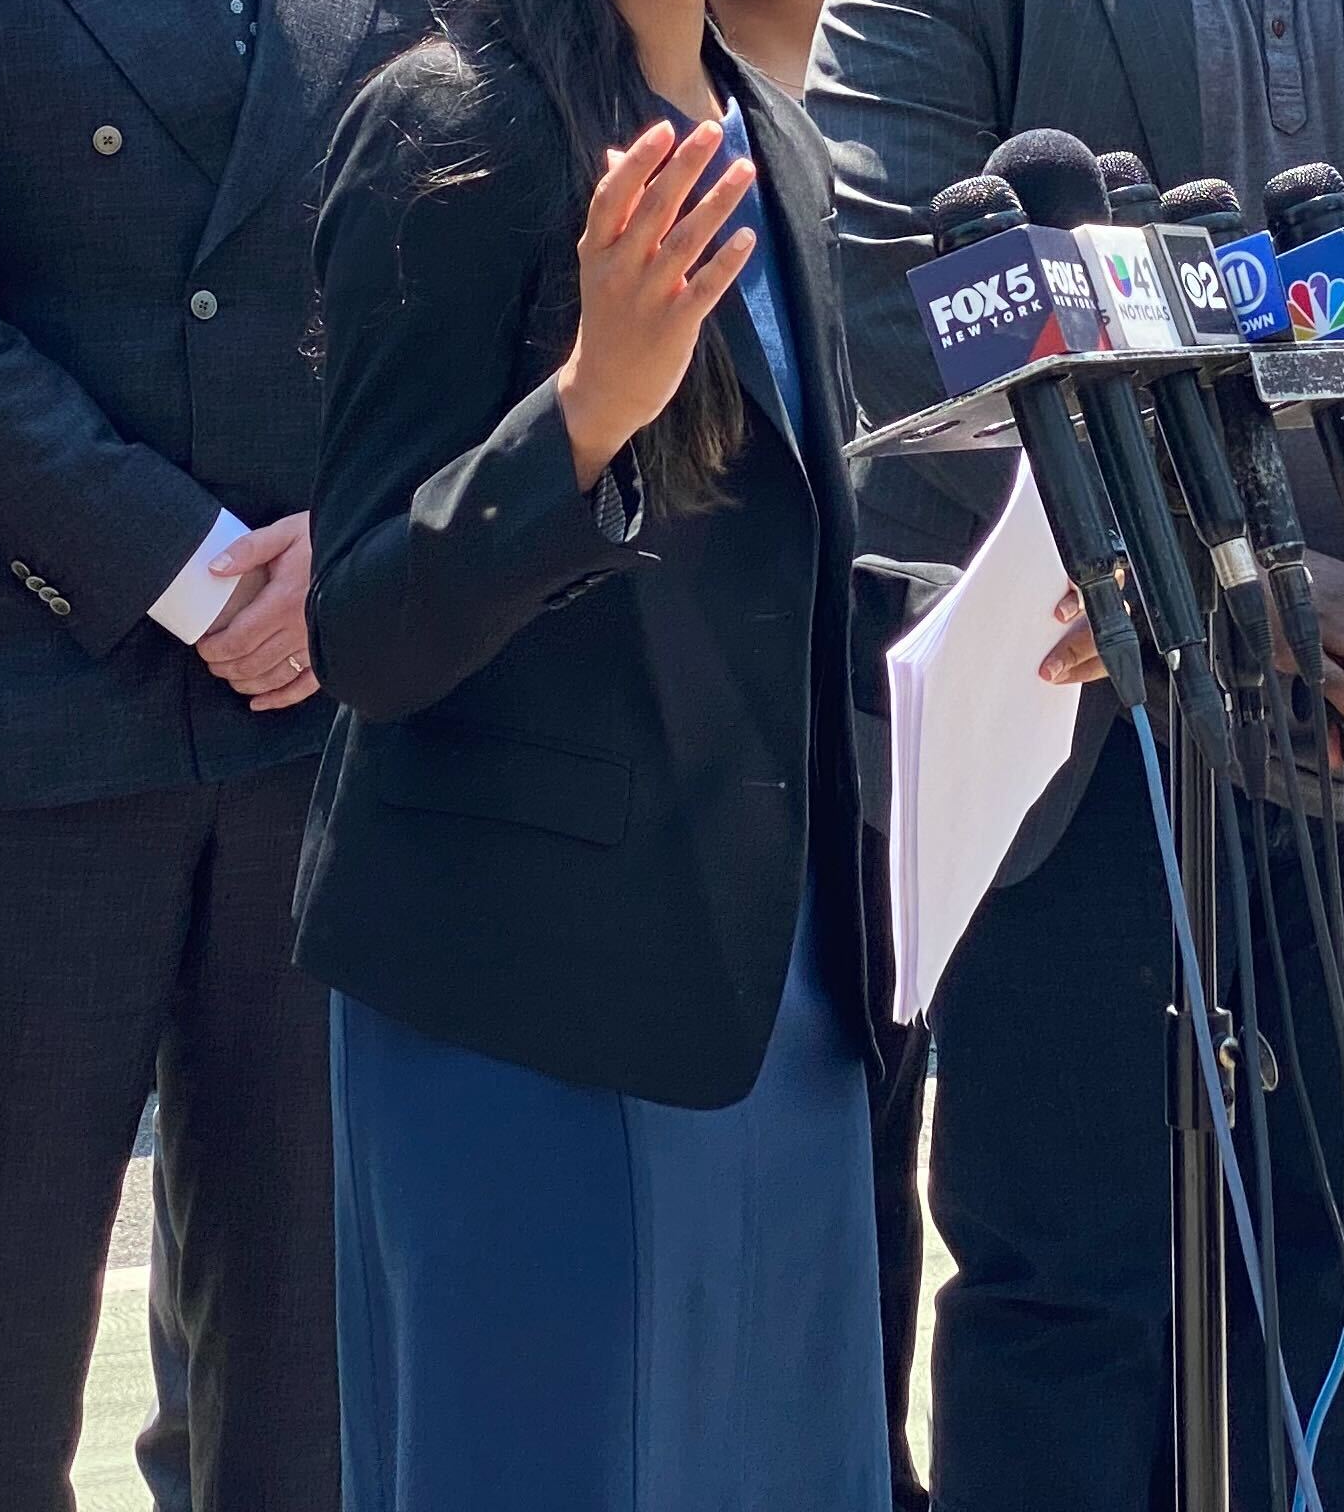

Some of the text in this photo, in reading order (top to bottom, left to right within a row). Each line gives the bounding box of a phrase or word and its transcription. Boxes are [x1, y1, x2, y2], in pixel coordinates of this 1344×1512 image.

[1133, 255, 1162, 299] 41
[1053, 294, 1073, 308] NEW
[1118, 303, 1171, 322] NOTICIAS
[941, 299, 1043, 349] NEW YORK
